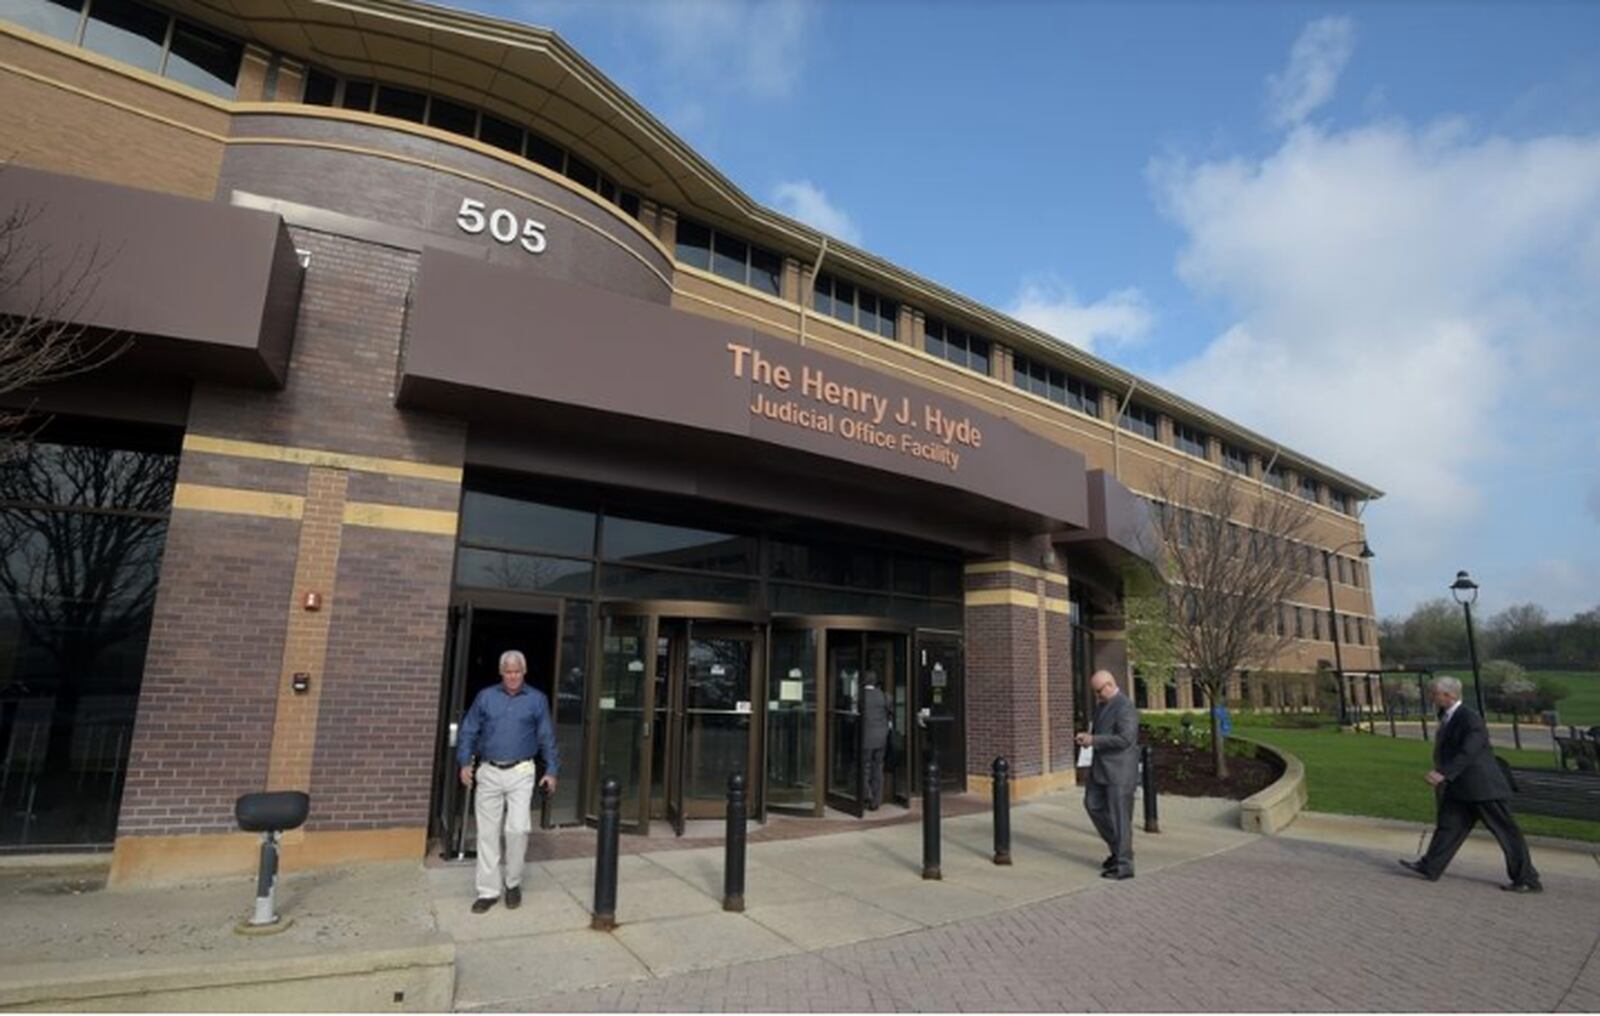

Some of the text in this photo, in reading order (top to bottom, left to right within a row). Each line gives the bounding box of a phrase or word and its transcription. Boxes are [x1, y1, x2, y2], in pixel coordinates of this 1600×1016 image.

[456, 197, 547, 254] 505
[728, 343, 982, 447] The Henry J. Hyde
[751, 394, 960, 470] Judicial Office Facility
